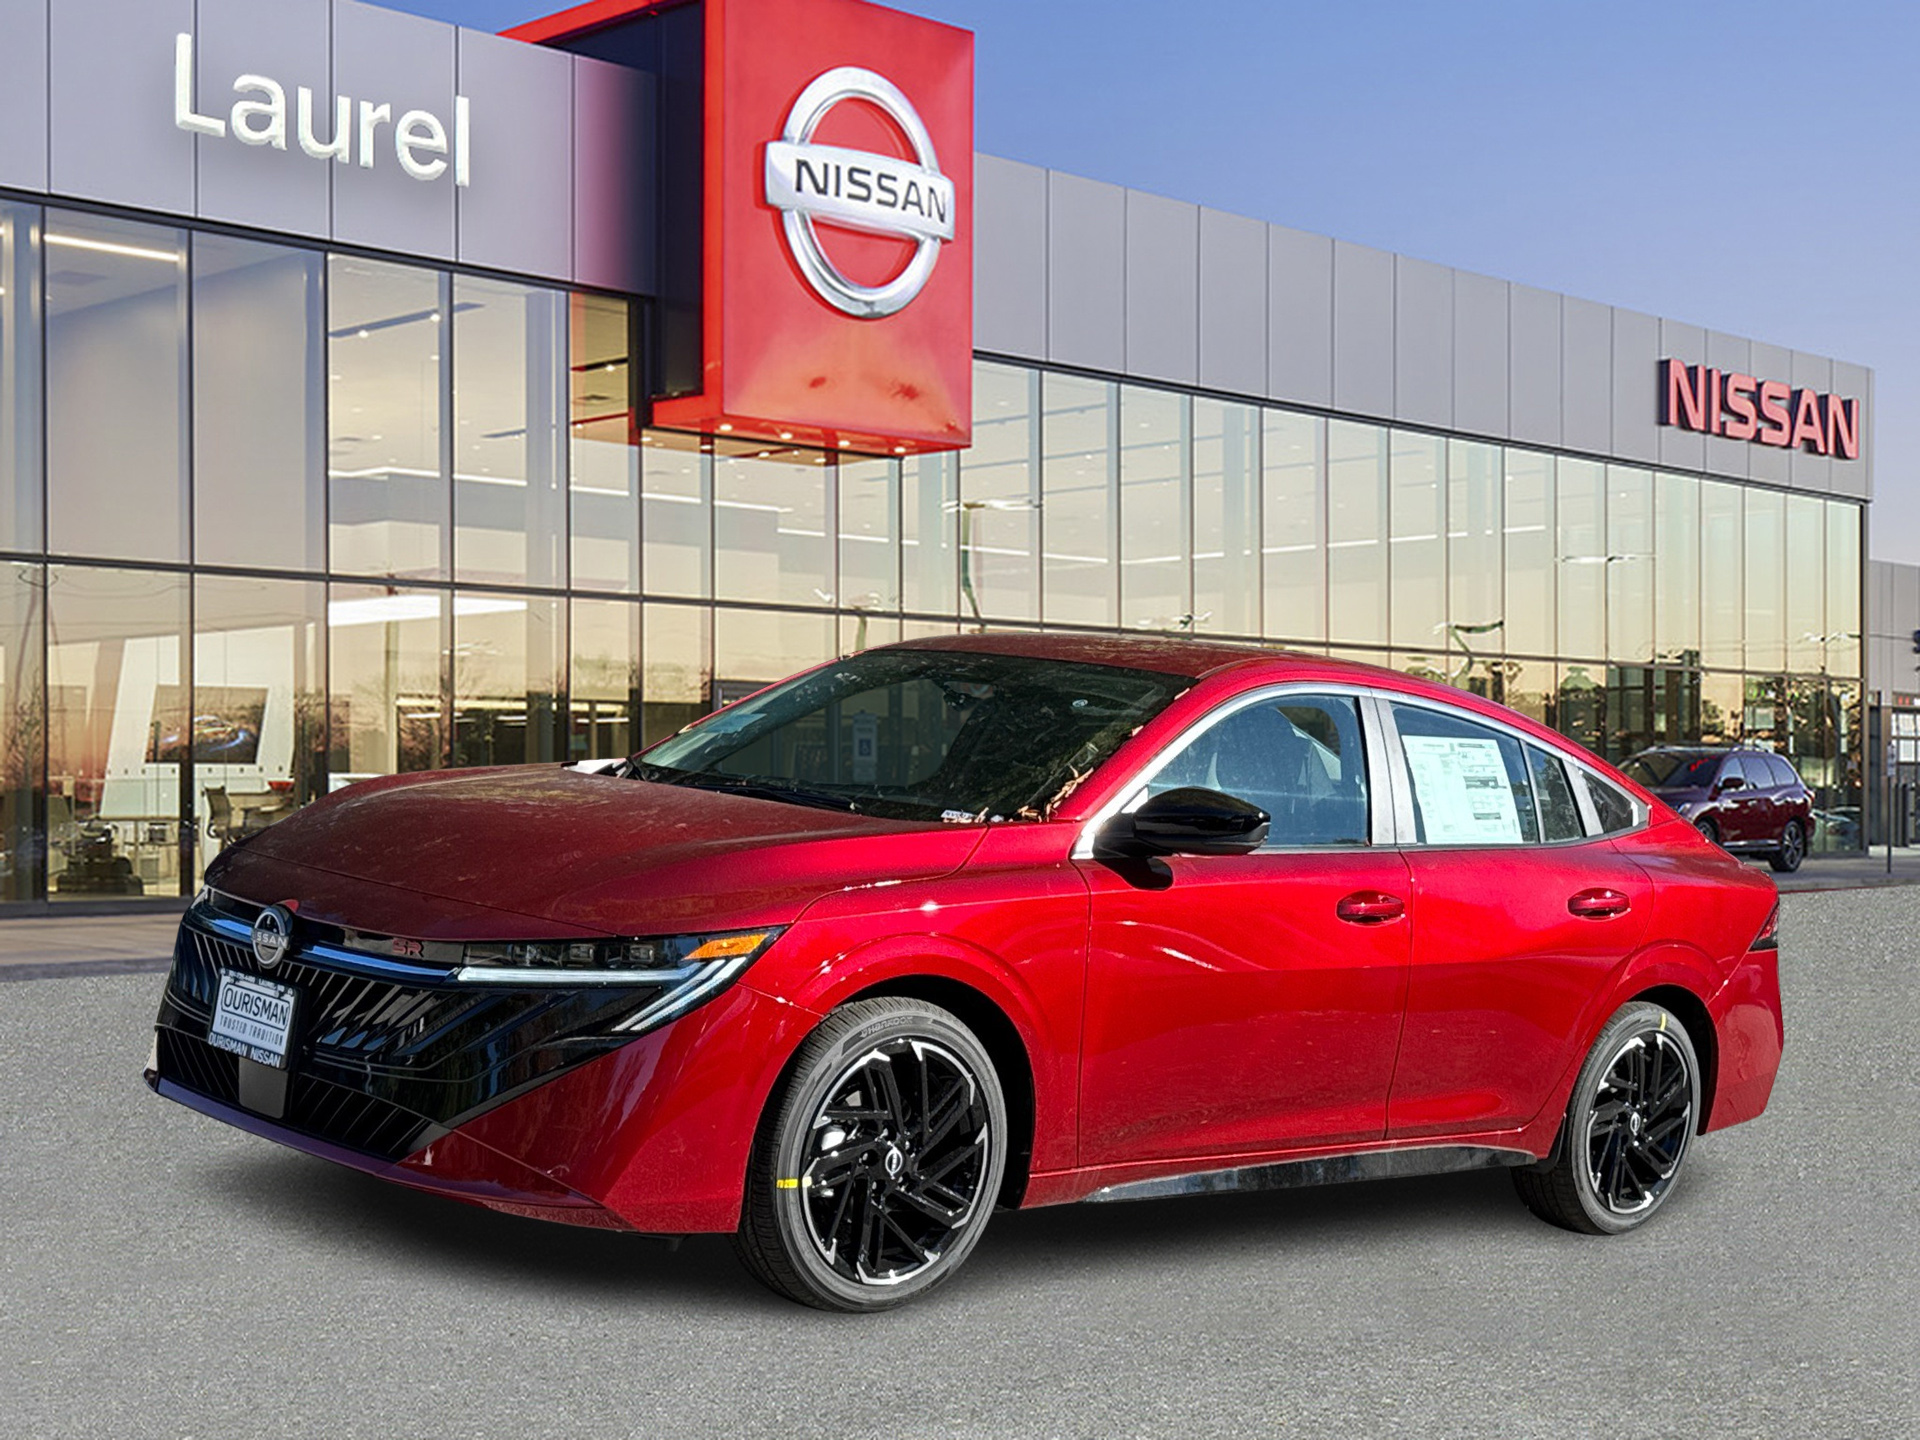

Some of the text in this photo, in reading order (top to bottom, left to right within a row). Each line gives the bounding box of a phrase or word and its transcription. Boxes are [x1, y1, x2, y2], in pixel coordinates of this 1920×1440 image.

[175, 32, 470, 187] Laurel
[795, 158, 947, 224] NISSAN
[1660, 358, 1860, 460] NISSAN
[392, 938, 424, 958] SR
[220, 1014, 248, 1035] TRUSTED
[223, 987, 288, 1026] OURISMAN
[208, 1032, 281, 1069] OURISMAN NISSAN
